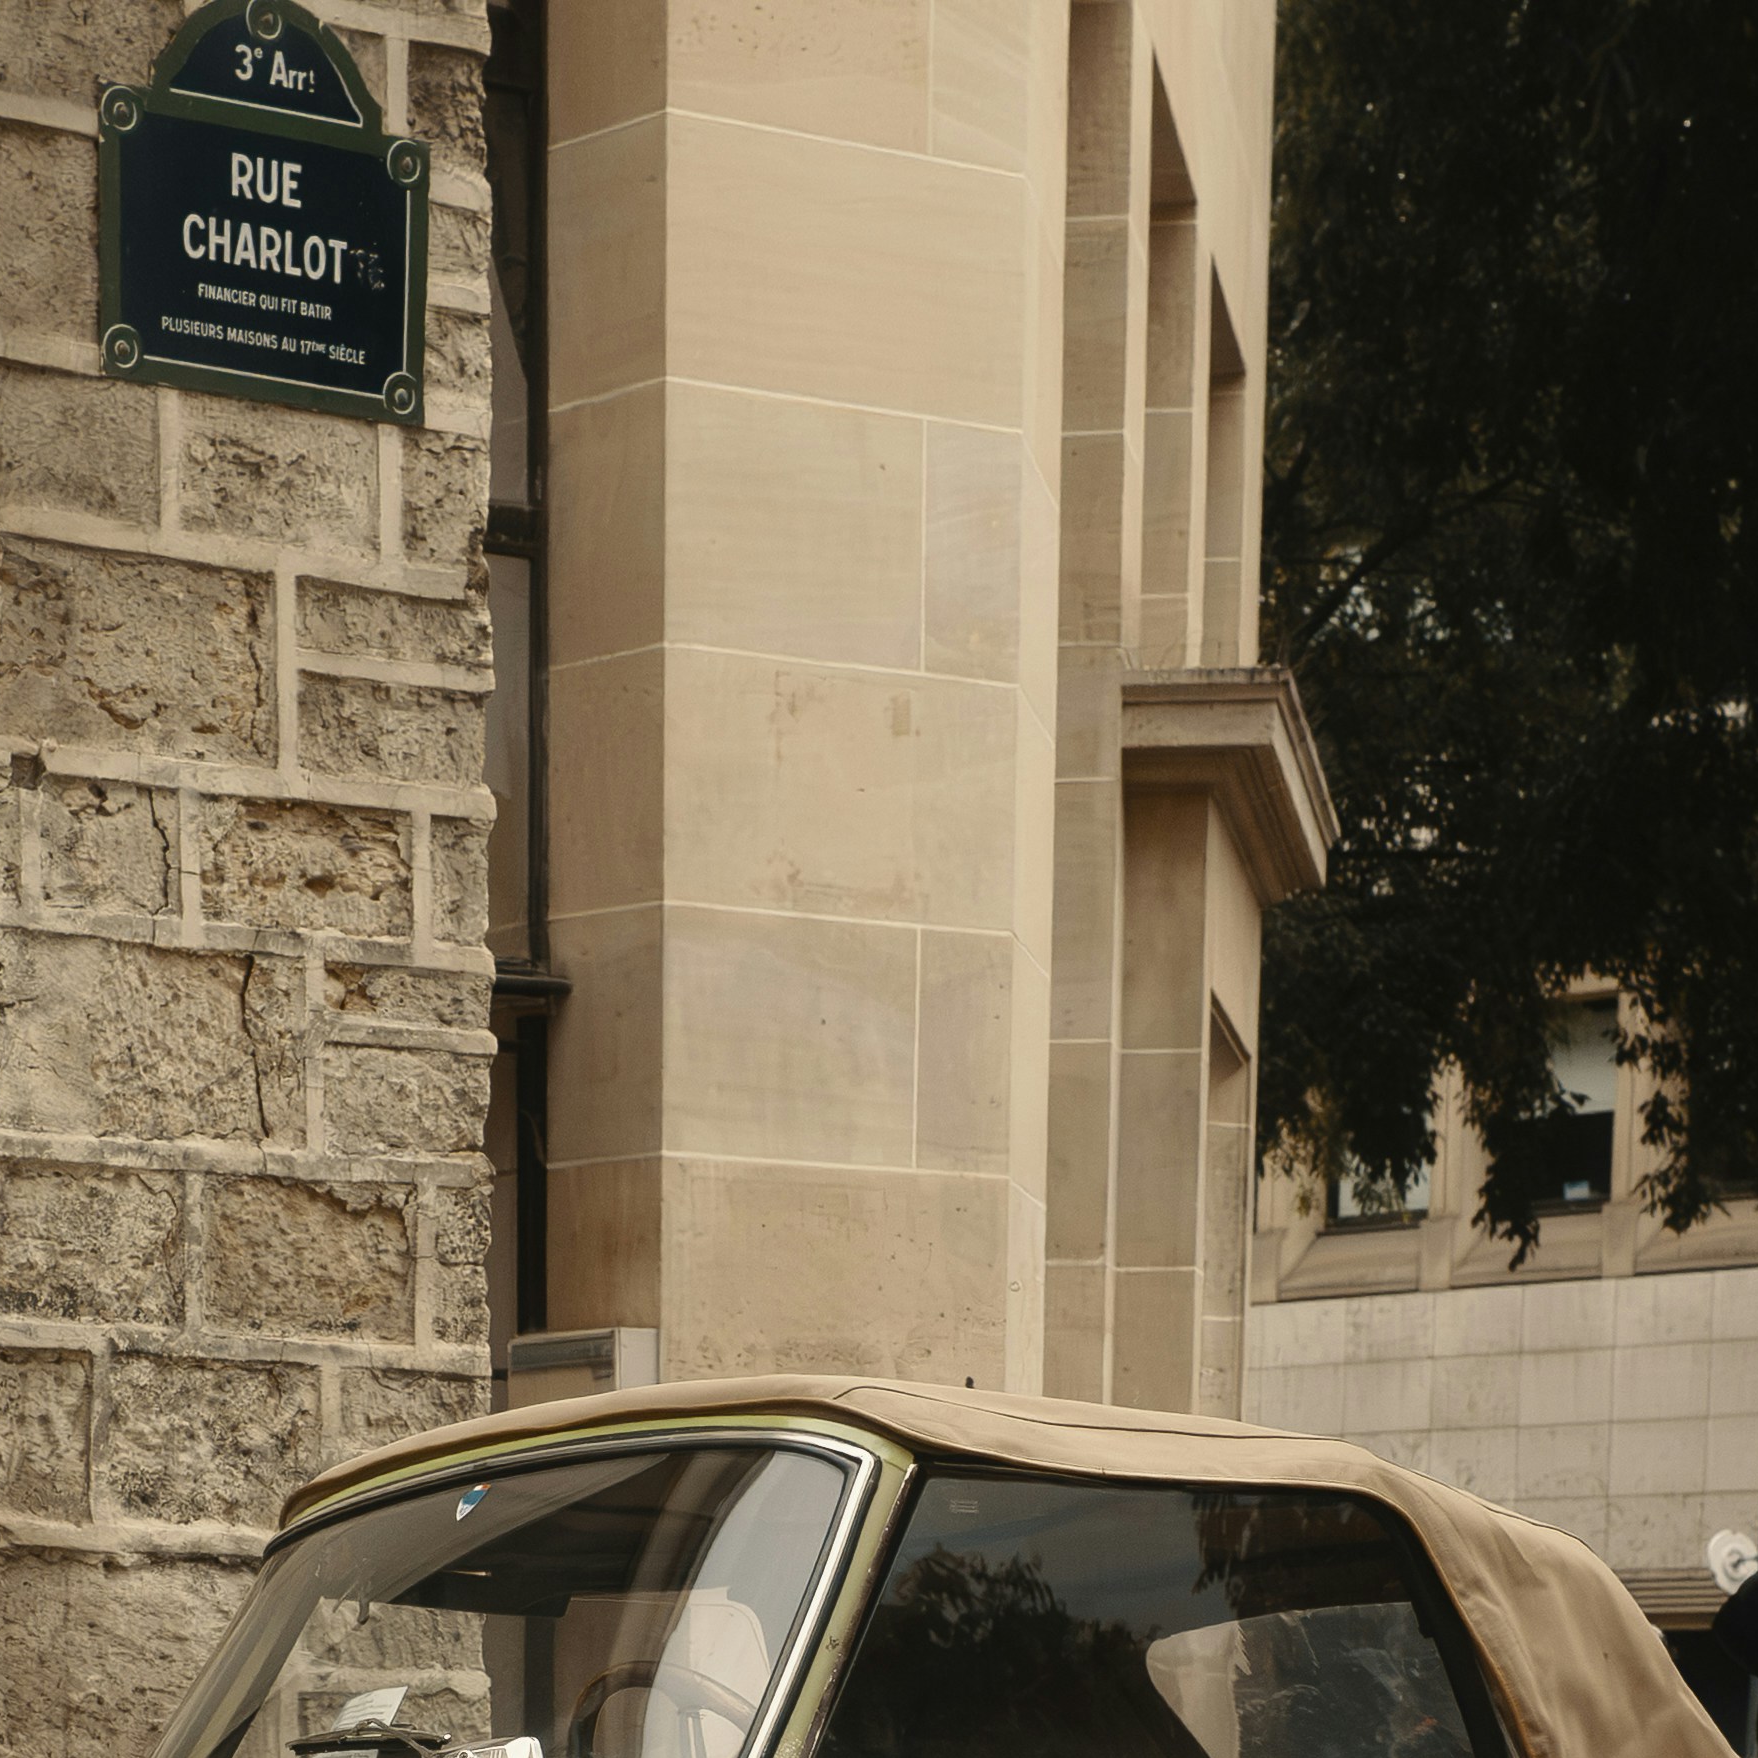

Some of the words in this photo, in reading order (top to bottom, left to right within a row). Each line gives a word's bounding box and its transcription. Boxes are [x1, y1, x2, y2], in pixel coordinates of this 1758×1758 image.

[231, 152, 302, 208] RUE
[182, 213, 348, 285] CHARLOT
[198, 283, 256, 308] FINANCIER
[259, 294, 279, 311] QUI
[281, 298, 298, 315] FIT
[300, 301, 332, 321] BATIR
[161, 315, 224, 340] PLUSIEURS
[227, 326, 278, 350] MAISONS
[281, 336, 296, 353] AU
